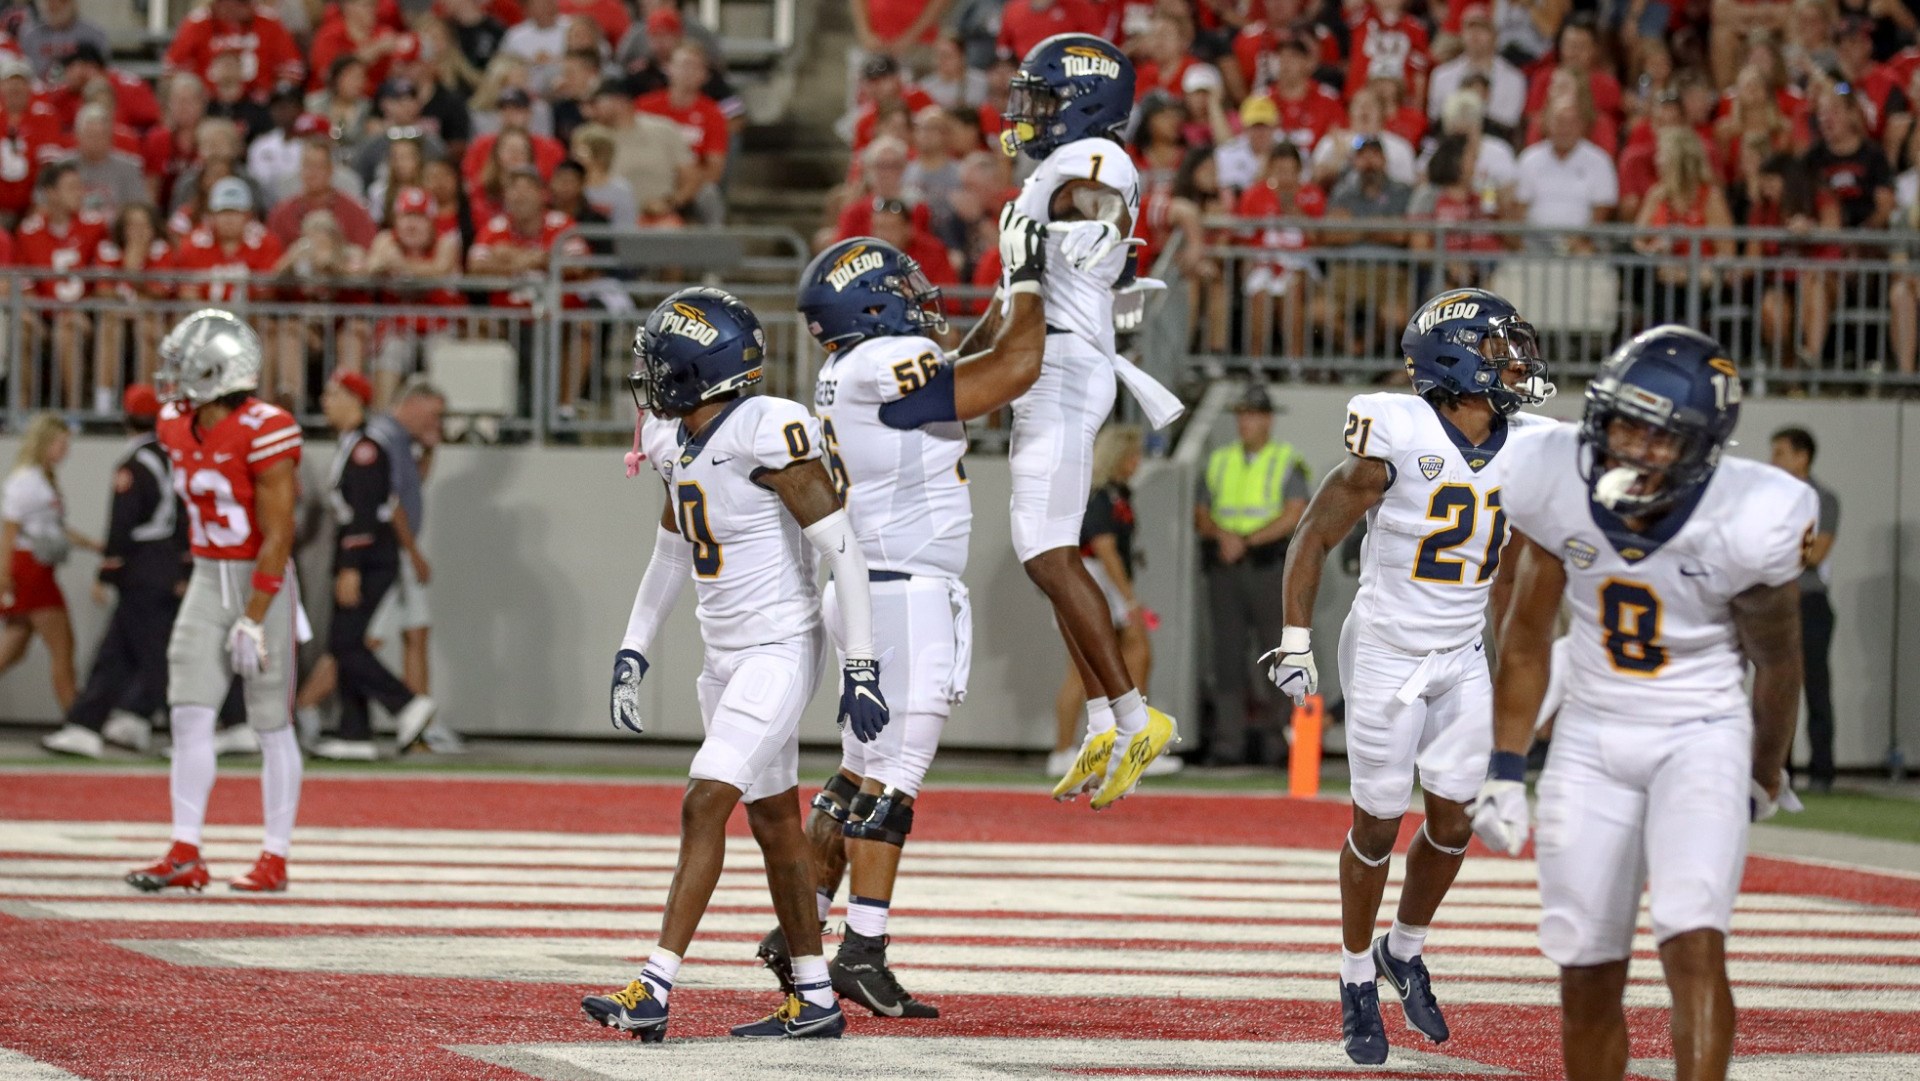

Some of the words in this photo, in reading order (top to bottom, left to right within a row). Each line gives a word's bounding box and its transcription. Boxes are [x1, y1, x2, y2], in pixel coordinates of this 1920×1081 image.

[1061, 55, 1120, 79] TOLEDO
[1091, 155, 1103, 181] 1
[826, 251, 884, 292] TOLEDO
[659, 311, 718, 346] TOLEDO
[1418, 302, 1480, 335] TOLEDO
[893, 352, 939, 396] 56
[782, 421, 811, 460] 0
[1344, 412, 1373, 457] 21
[173, 467, 251, 548] 13
[677, 480, 724, 580] 0
[1411, 482, 1509, 585] 21
[1598, 577, 1670, 679] 8
